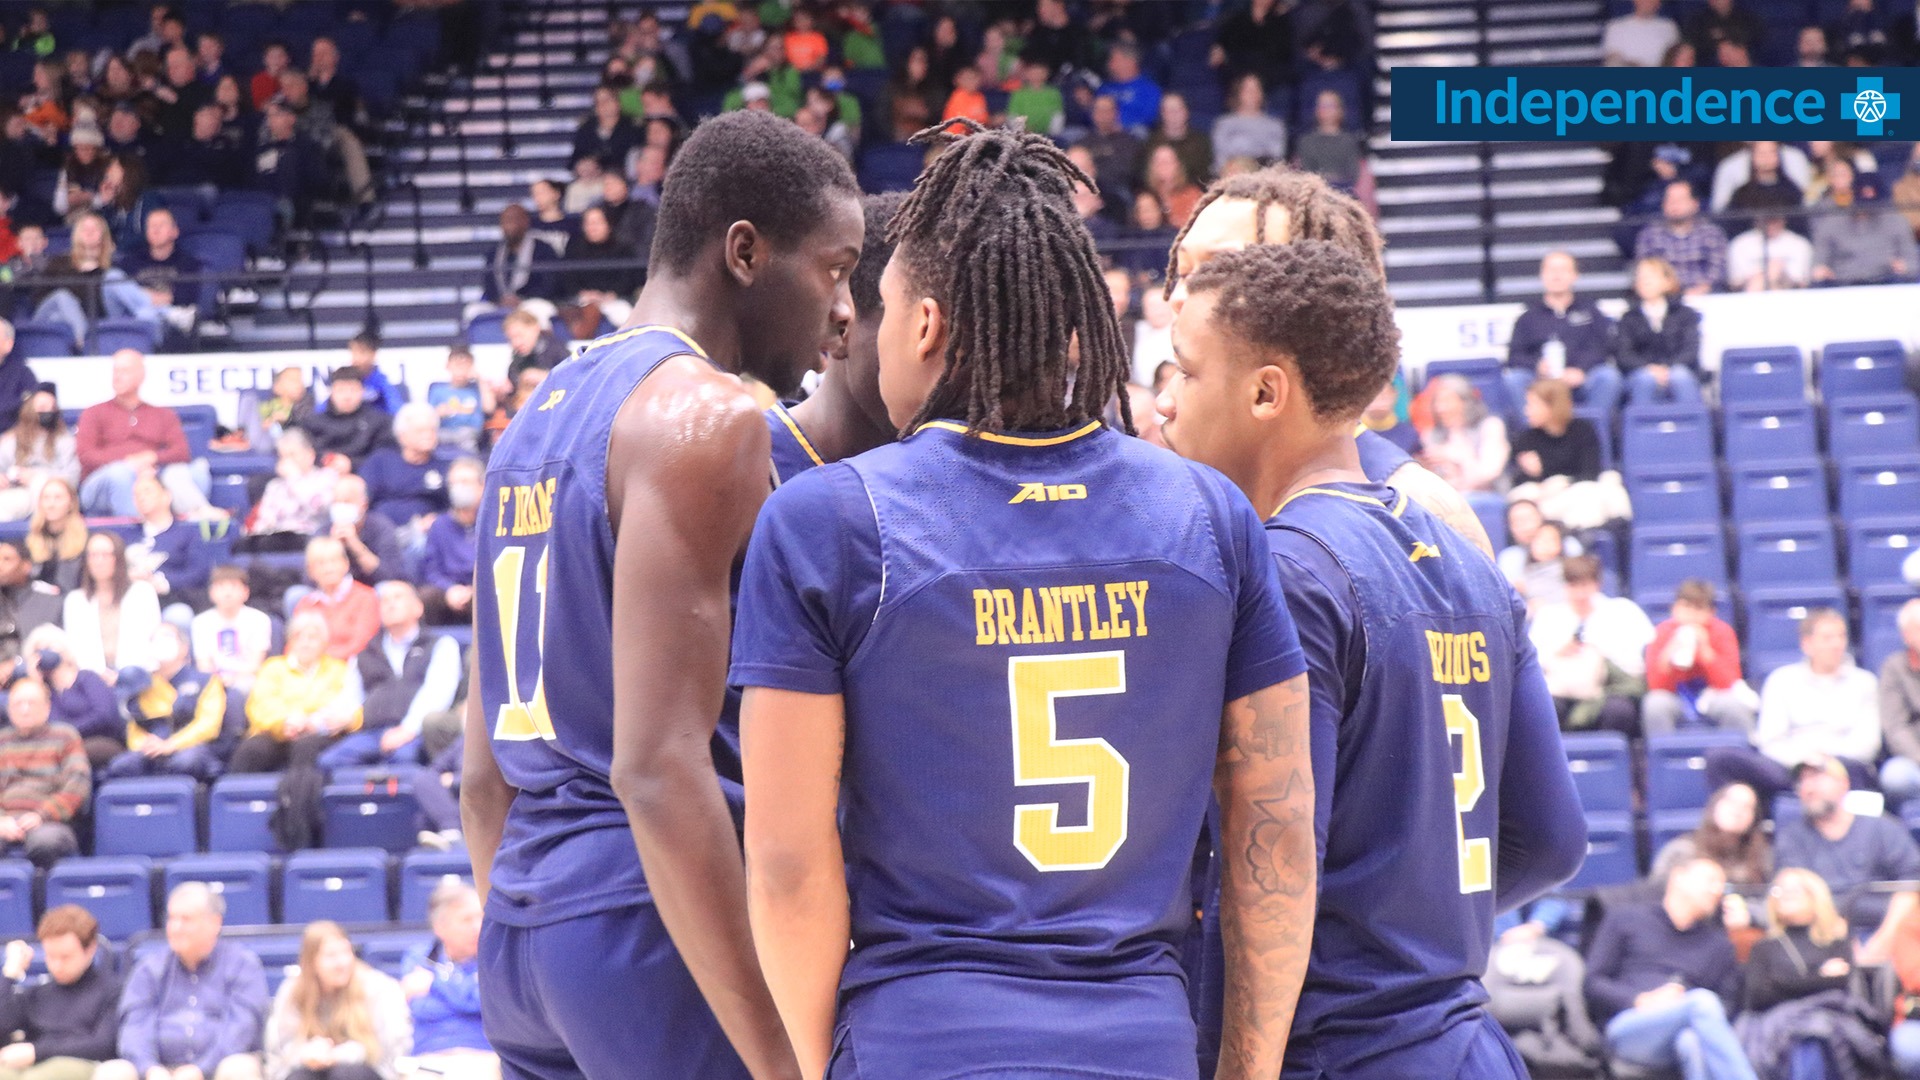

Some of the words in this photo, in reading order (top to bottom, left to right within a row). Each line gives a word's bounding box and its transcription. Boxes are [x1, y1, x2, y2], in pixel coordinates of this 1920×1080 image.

[493, 545, 557, 741] 11
[972, 580, 1150, 645] BRANTLEY
[1008, 649, 1130, 872] 5
[1441, 693, 1492, 894] 2
